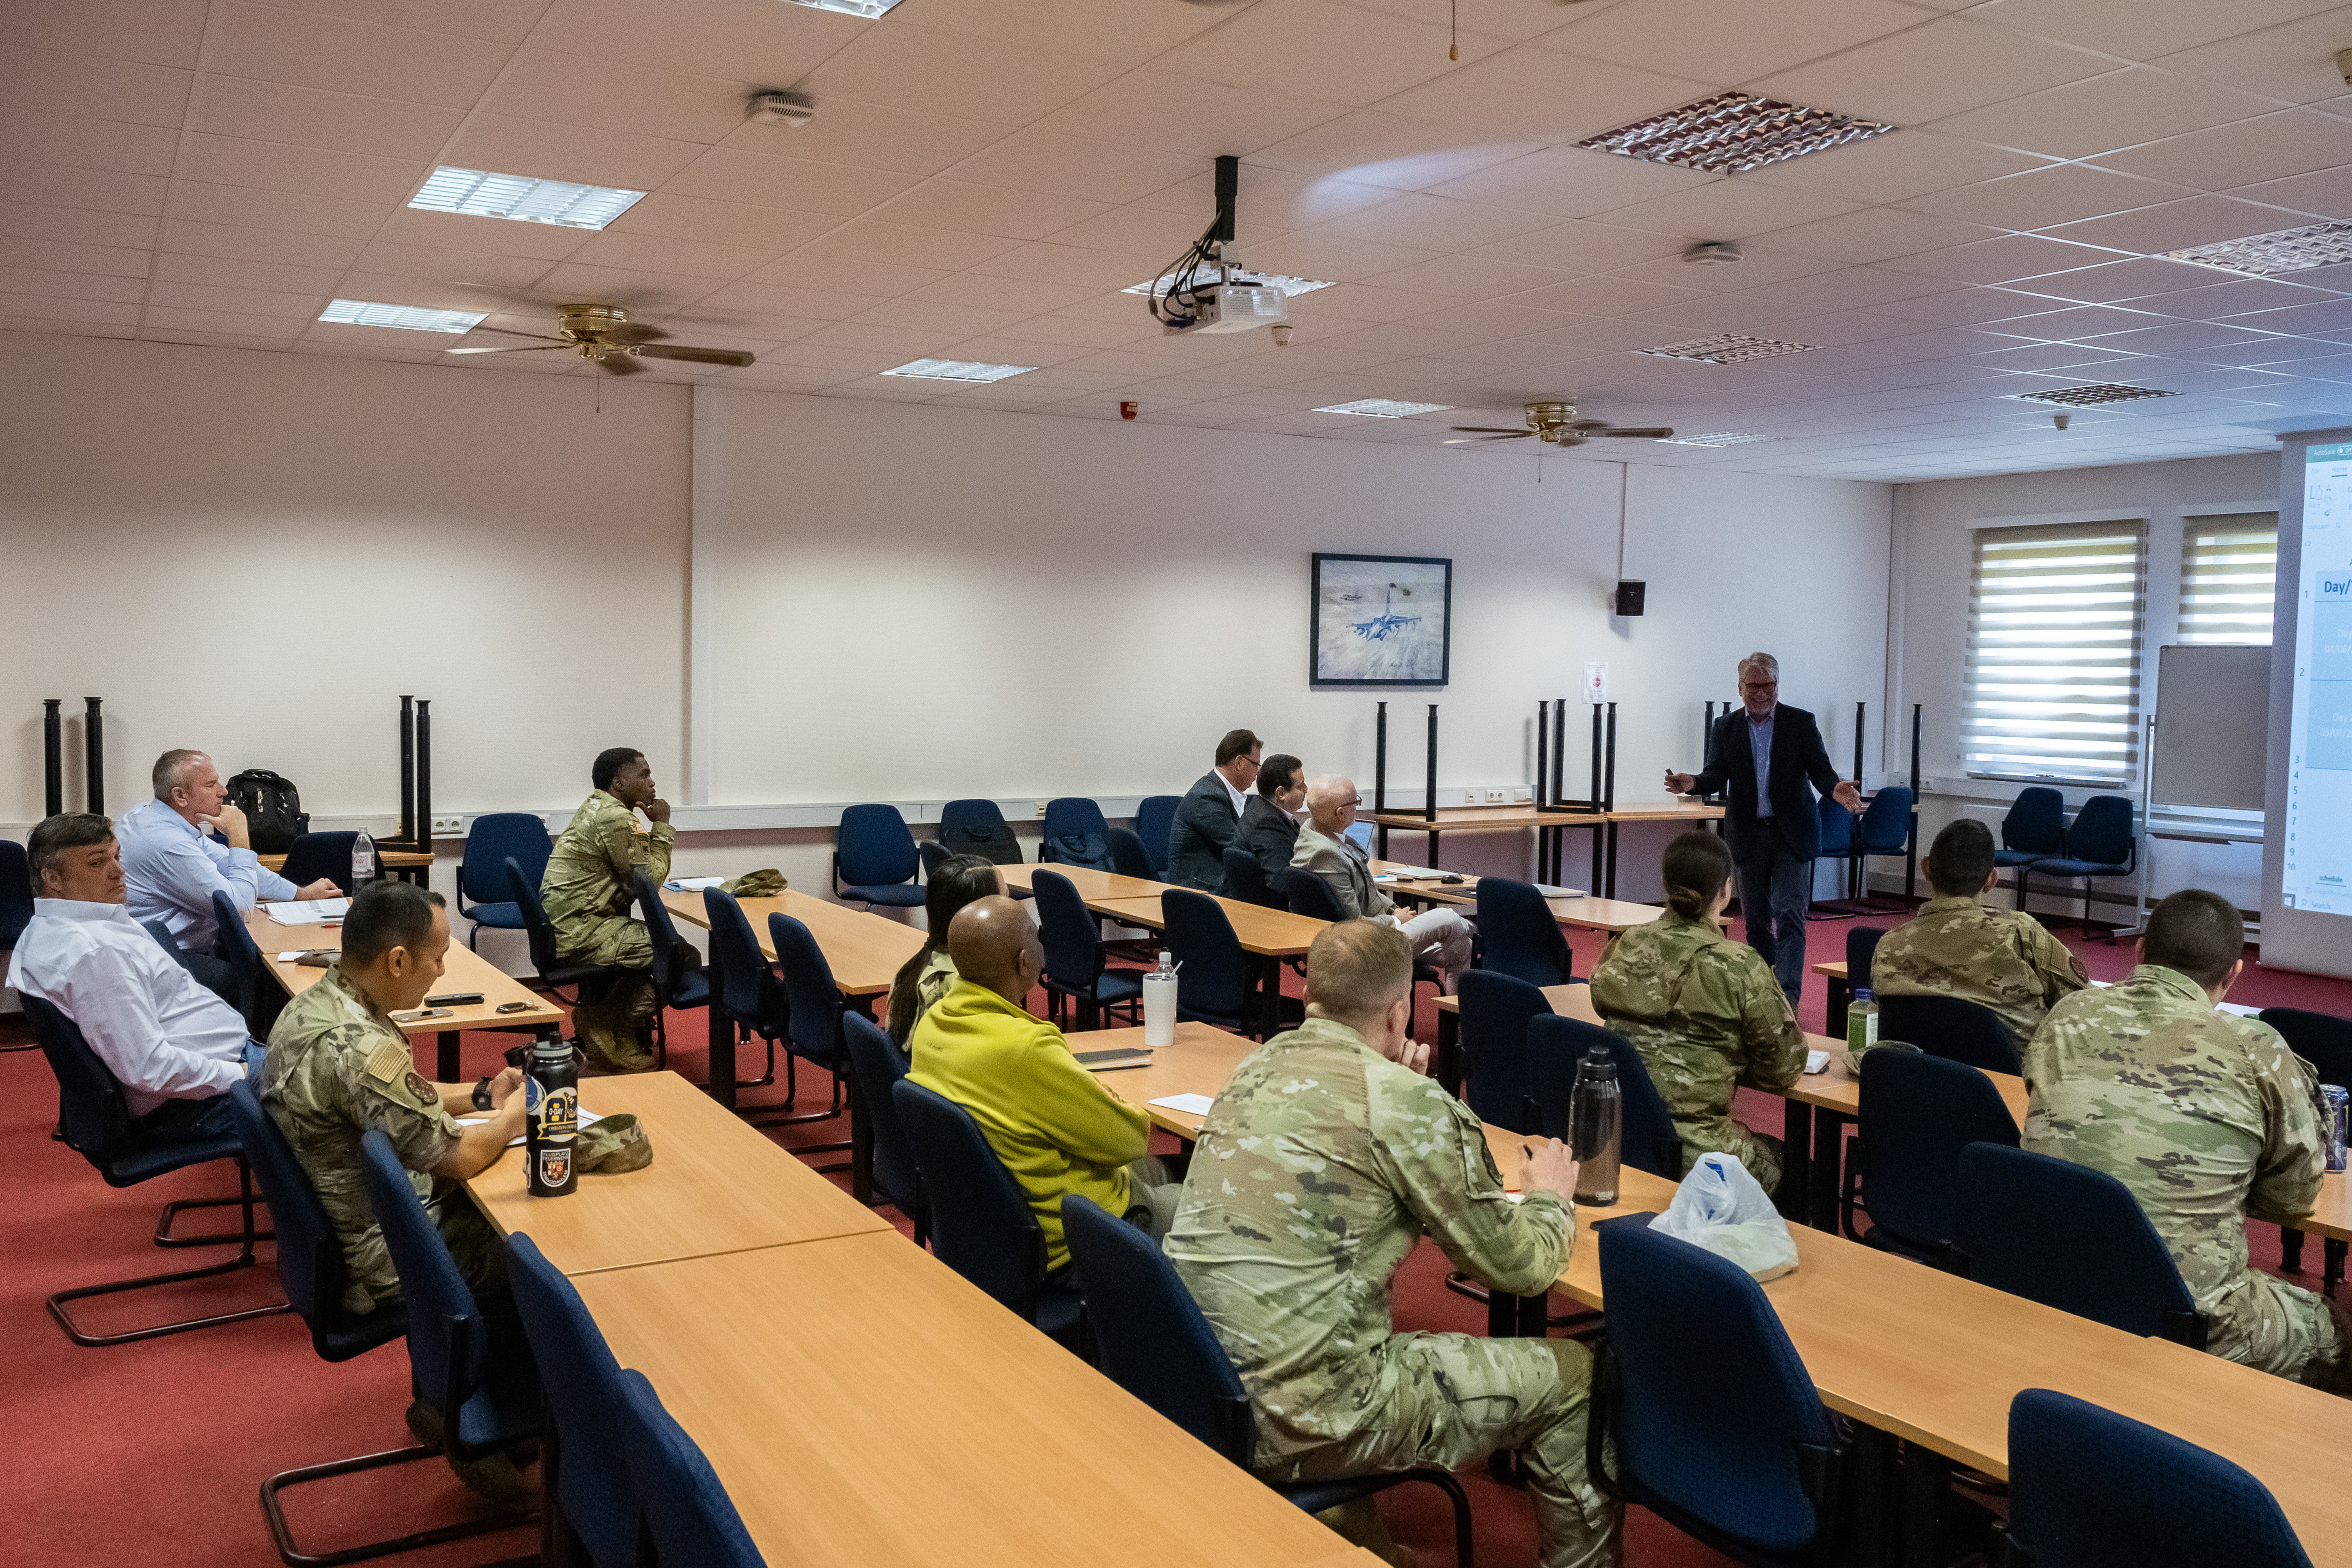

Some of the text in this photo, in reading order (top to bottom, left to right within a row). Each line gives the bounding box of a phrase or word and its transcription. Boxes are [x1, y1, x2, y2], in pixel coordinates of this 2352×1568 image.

[2324, 578, 2352, 595] Day/
[2305, 590, 2308, 599] 1
[2300, 668, 2305, 676] 2
[2294, 786, 2298, 795] 5
[2312, 901, 2330, 909] Search
